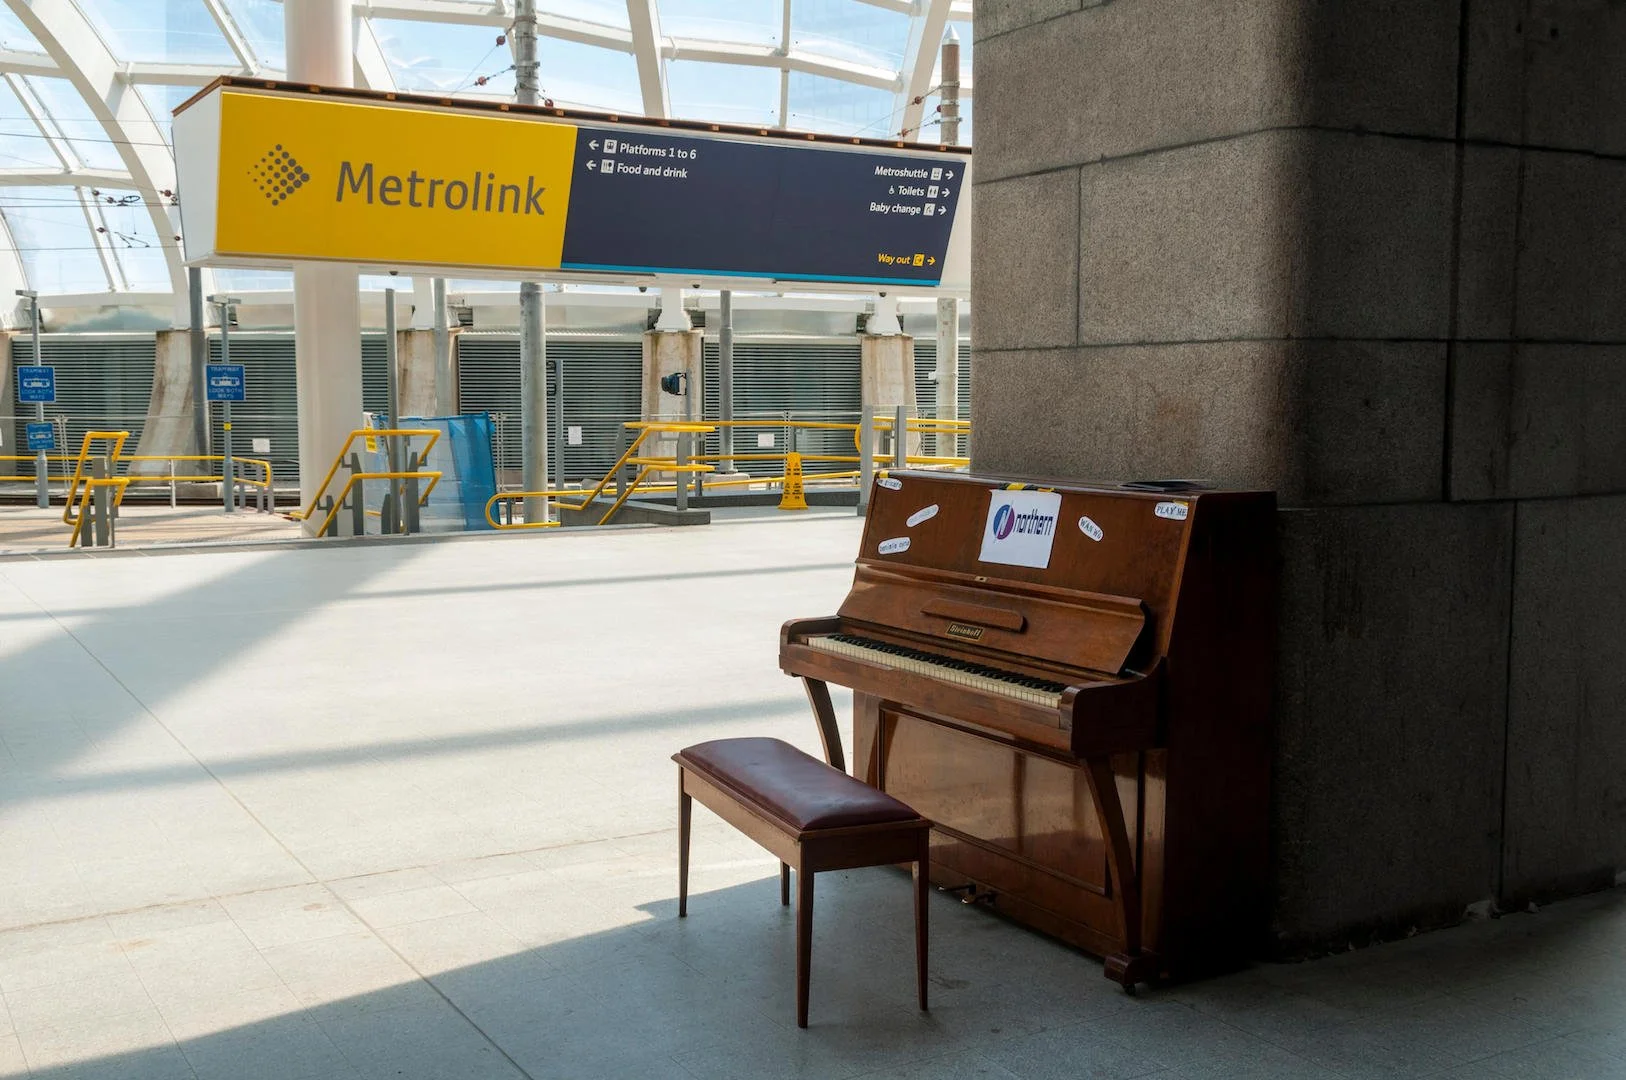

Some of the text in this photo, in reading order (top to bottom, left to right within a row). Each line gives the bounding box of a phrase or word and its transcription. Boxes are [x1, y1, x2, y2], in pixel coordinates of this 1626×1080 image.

[619, 142, 697, 160] Platforms 1 to 6
[616, 163, 688, 179] Food and drink
[874, 165, 929, 179] Metroshuttle
[336, 161, 546, 216] Metrolink
[898, 185, 925, 197] Toilets
[869, 201, 921, 216] Baby change
[878, 252, 911, 265] Way out
[1156, 505, 1187, 517] PLAY ME
[1013, 508, 1054, 536] northern
